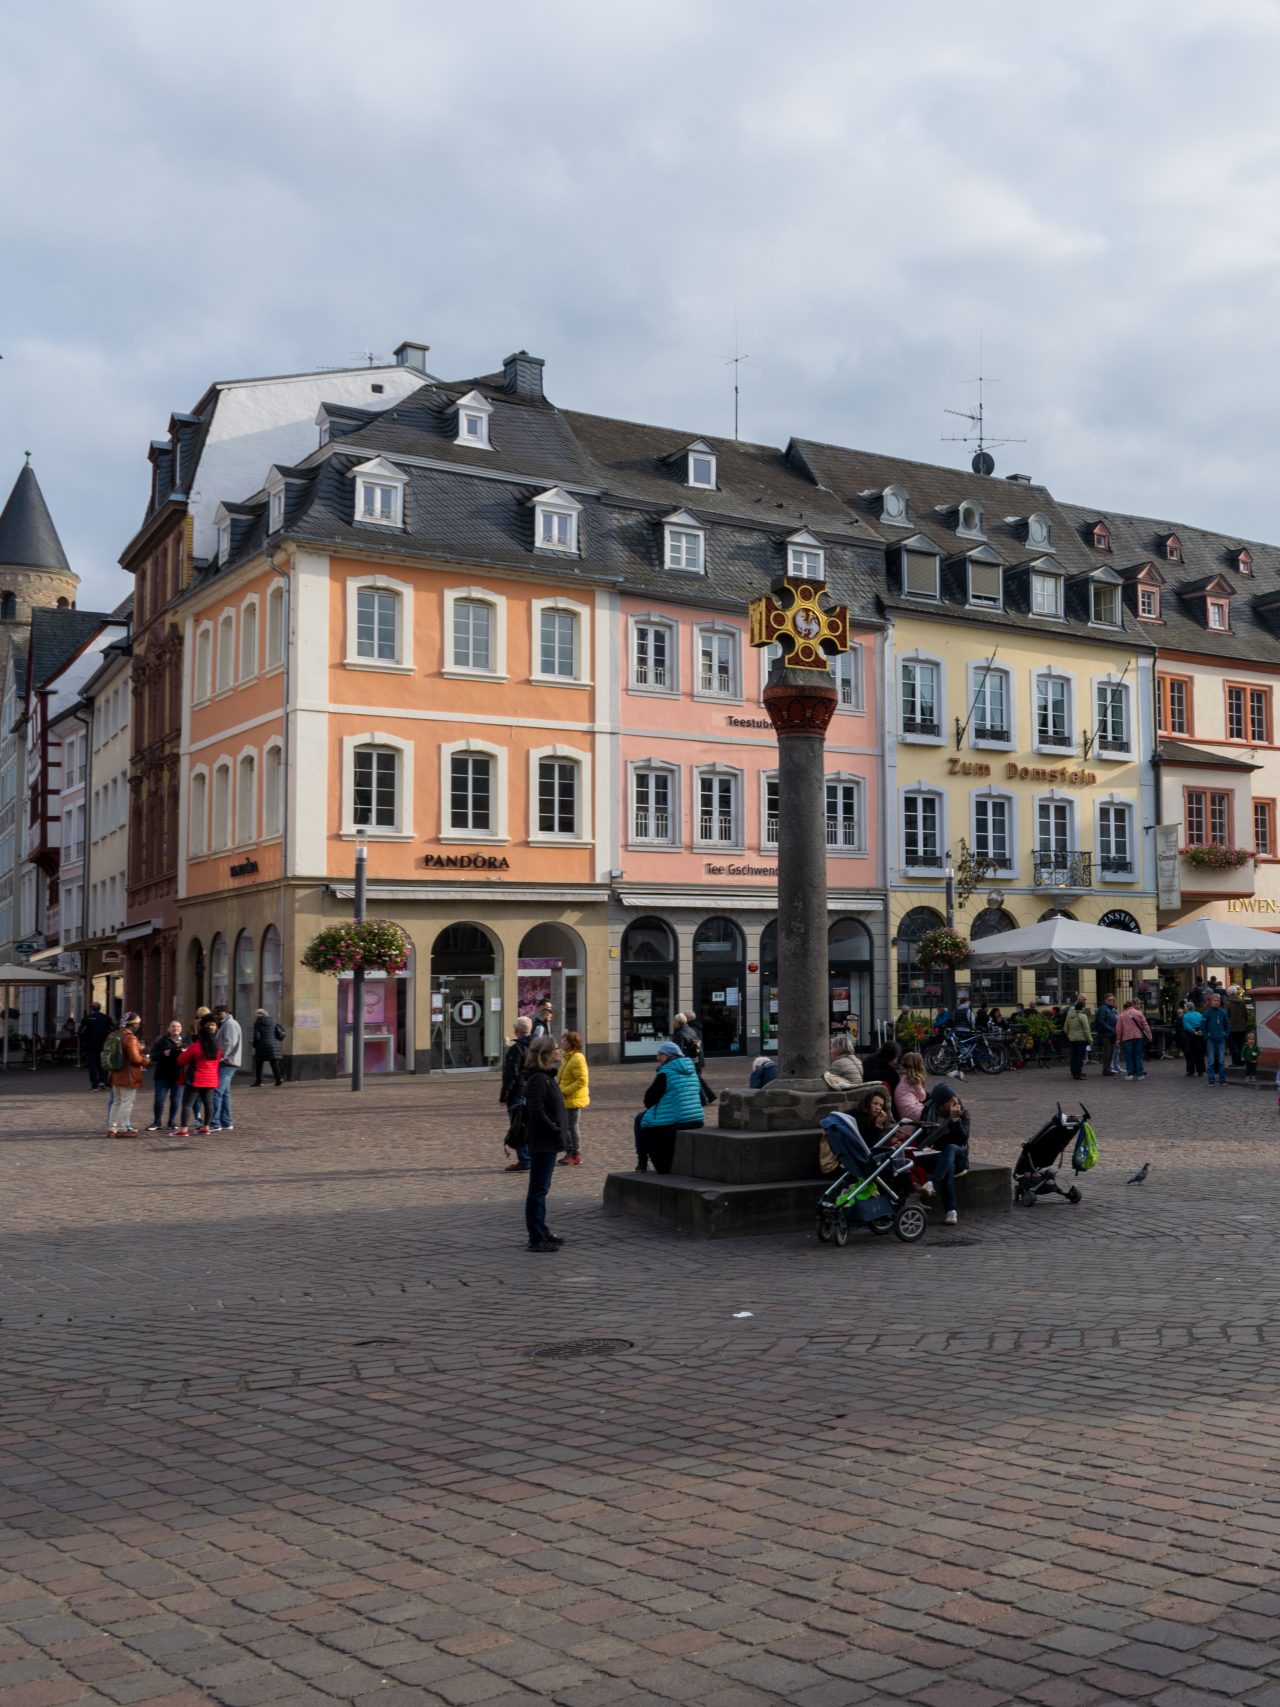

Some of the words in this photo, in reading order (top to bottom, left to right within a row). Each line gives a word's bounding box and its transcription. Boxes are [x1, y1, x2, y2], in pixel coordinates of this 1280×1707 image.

[948, 757, 991, 777] Zum
[1007, 762, 1097, 785] Domstein
[424, 853, 510, 869] PANDORA
[705, 863, 725, 875] Tee
